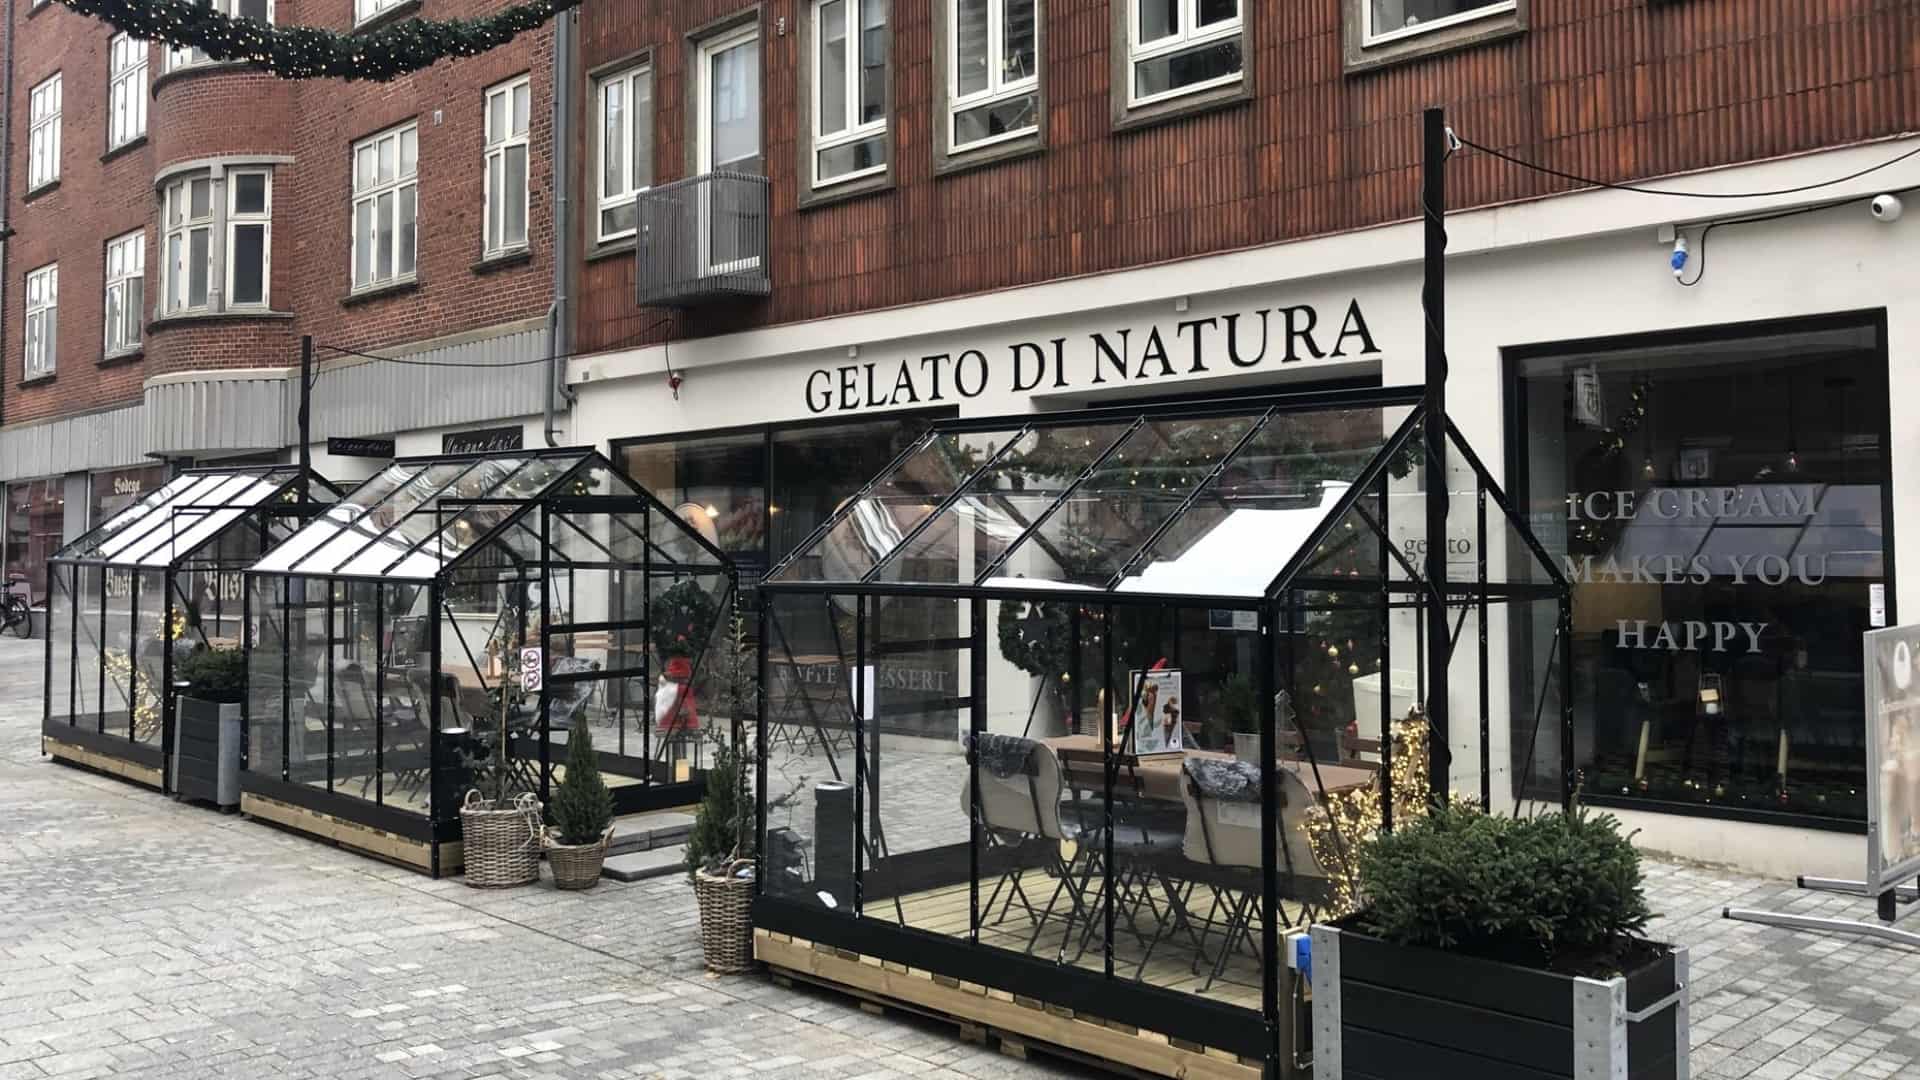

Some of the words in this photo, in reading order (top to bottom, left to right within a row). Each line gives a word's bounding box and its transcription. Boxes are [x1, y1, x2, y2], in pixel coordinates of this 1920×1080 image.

[805, 350, 989, 413] GELATO
[1008, 338, 1070, 392] DI
[1089, 297, 1382, 384] NATURA
[1566, 491, 1638, 520] ICE
[1653, 485, 1817, 519] CREAM
[1404, 537, 1471, 563] geto
[105, 567, 146, 598] Bustr
[1562, 553, 1711, 584] MAKES
[1728, 553, 1829, 586] YOU
[1615, 618, 1769, 653] HAPPY
[877, 668, 948, 692] ESSERT
